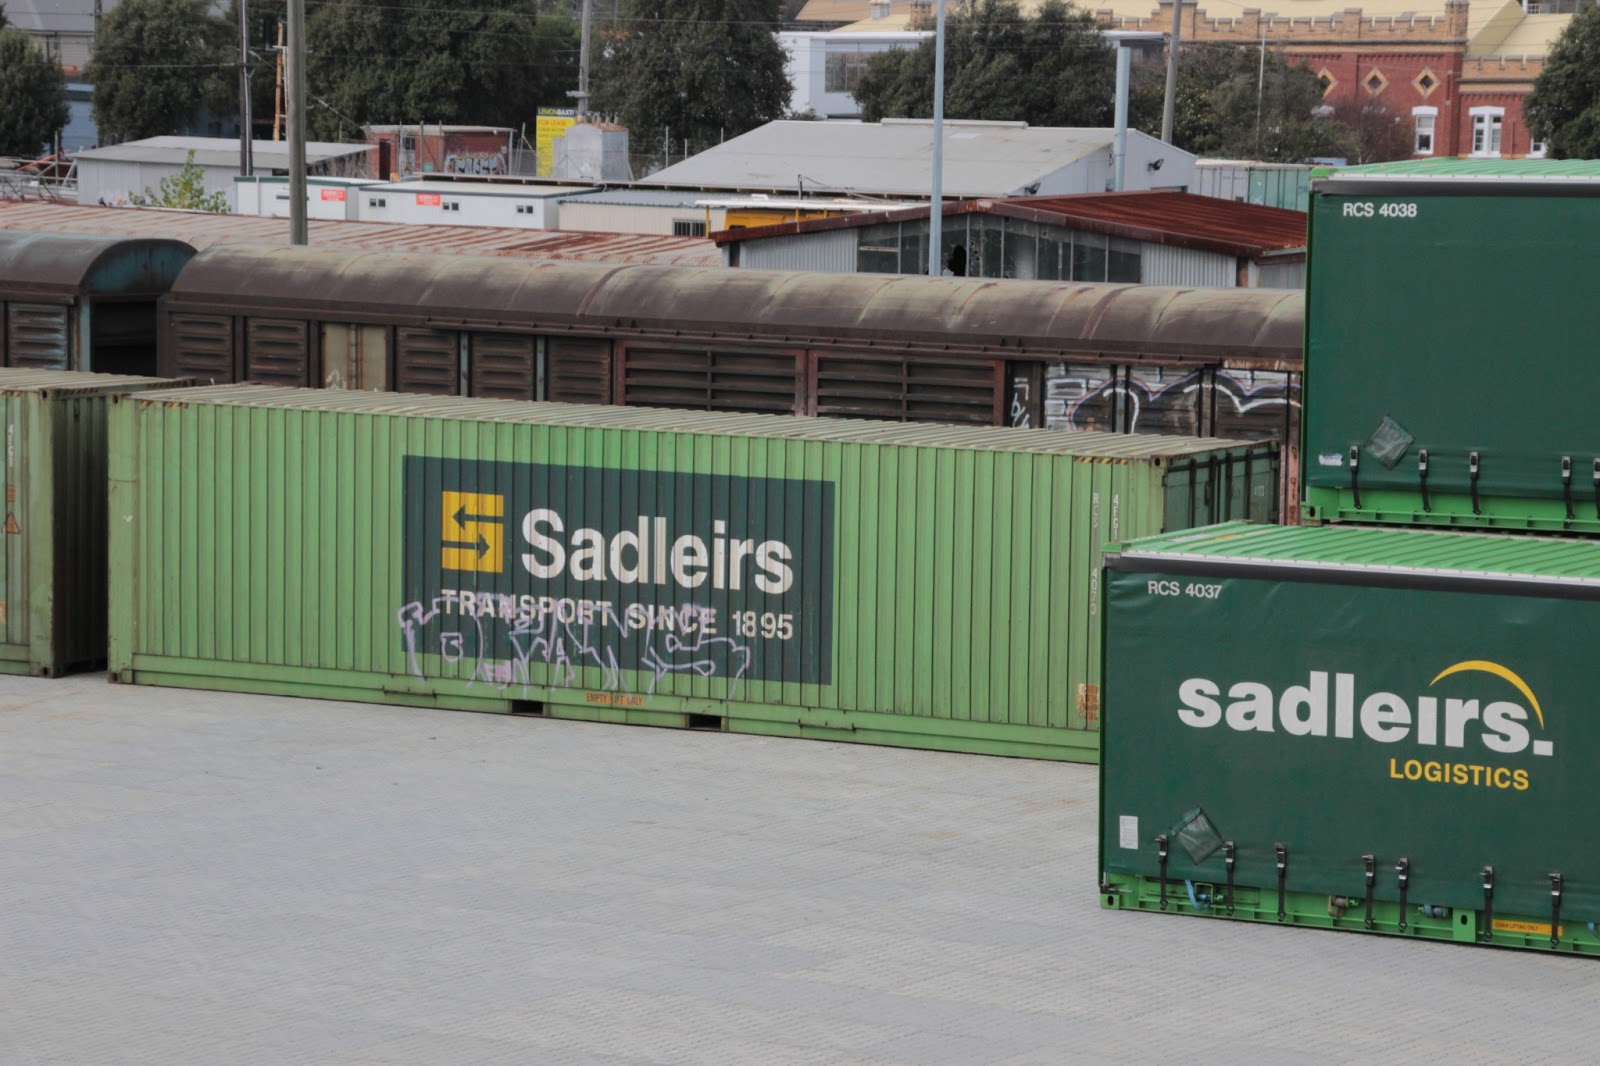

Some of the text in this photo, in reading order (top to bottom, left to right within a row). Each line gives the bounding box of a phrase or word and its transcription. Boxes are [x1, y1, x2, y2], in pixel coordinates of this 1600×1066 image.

[1343, 202, 1418, 217] RCS 4038
[521, 508, 794, 594] Sadleirs
[1148, 580, 1223, 599] RCS 4037
[441, 589, 793, 640] TRANSPORT SINCE 1895
[586, 692, 609, 704] EMPTY
[1390, 758, 1529, 790] LOGISTICS
